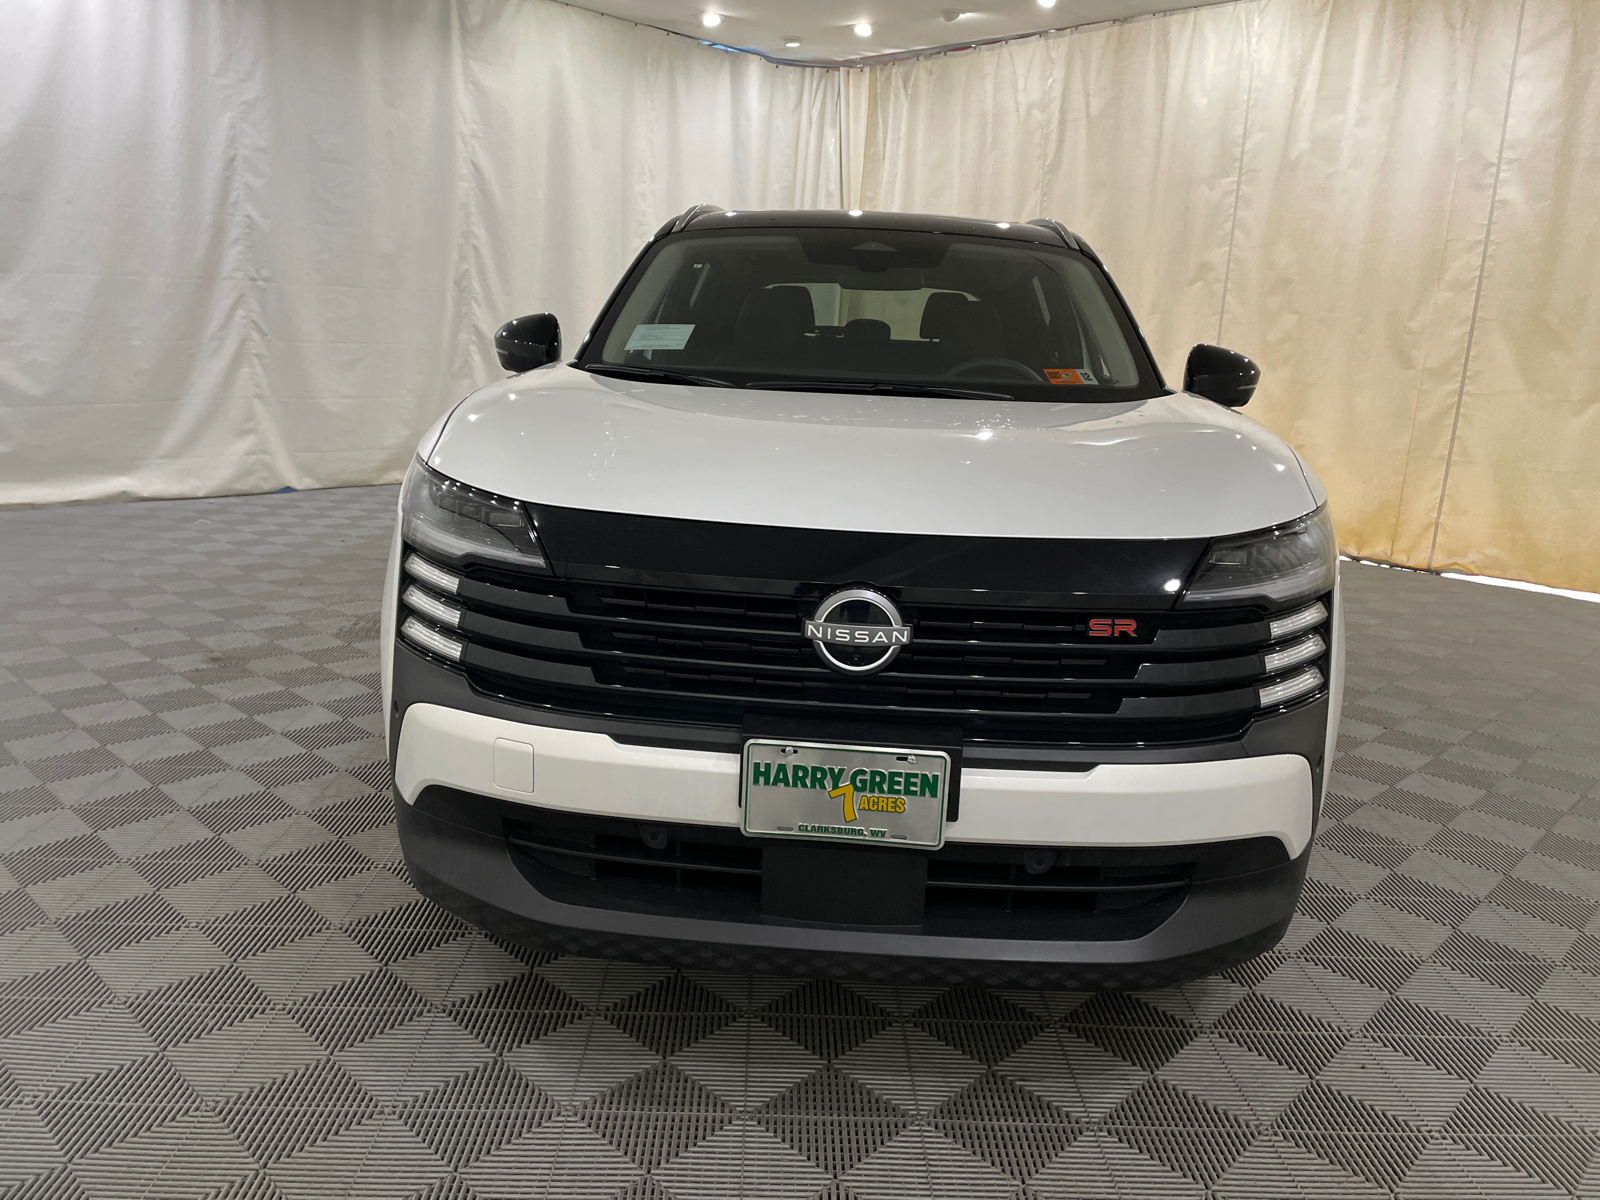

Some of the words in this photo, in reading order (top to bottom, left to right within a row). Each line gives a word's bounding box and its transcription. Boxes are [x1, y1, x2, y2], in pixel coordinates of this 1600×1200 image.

[1080, 372, 1093, 381] 12
[807, 624, 909, 643] NISSAN
[1088, 618, 1137, 637] SR
[752, 761, 845, 790] HARRY
[850, 768, 940, 798] GREEN
[828, 783, 857, 823] 7
[858, 795, 906, 813] ACRES
[798, 824, 867, 837] CLARKSBURG,
[870, 828, 887, 838] WV
